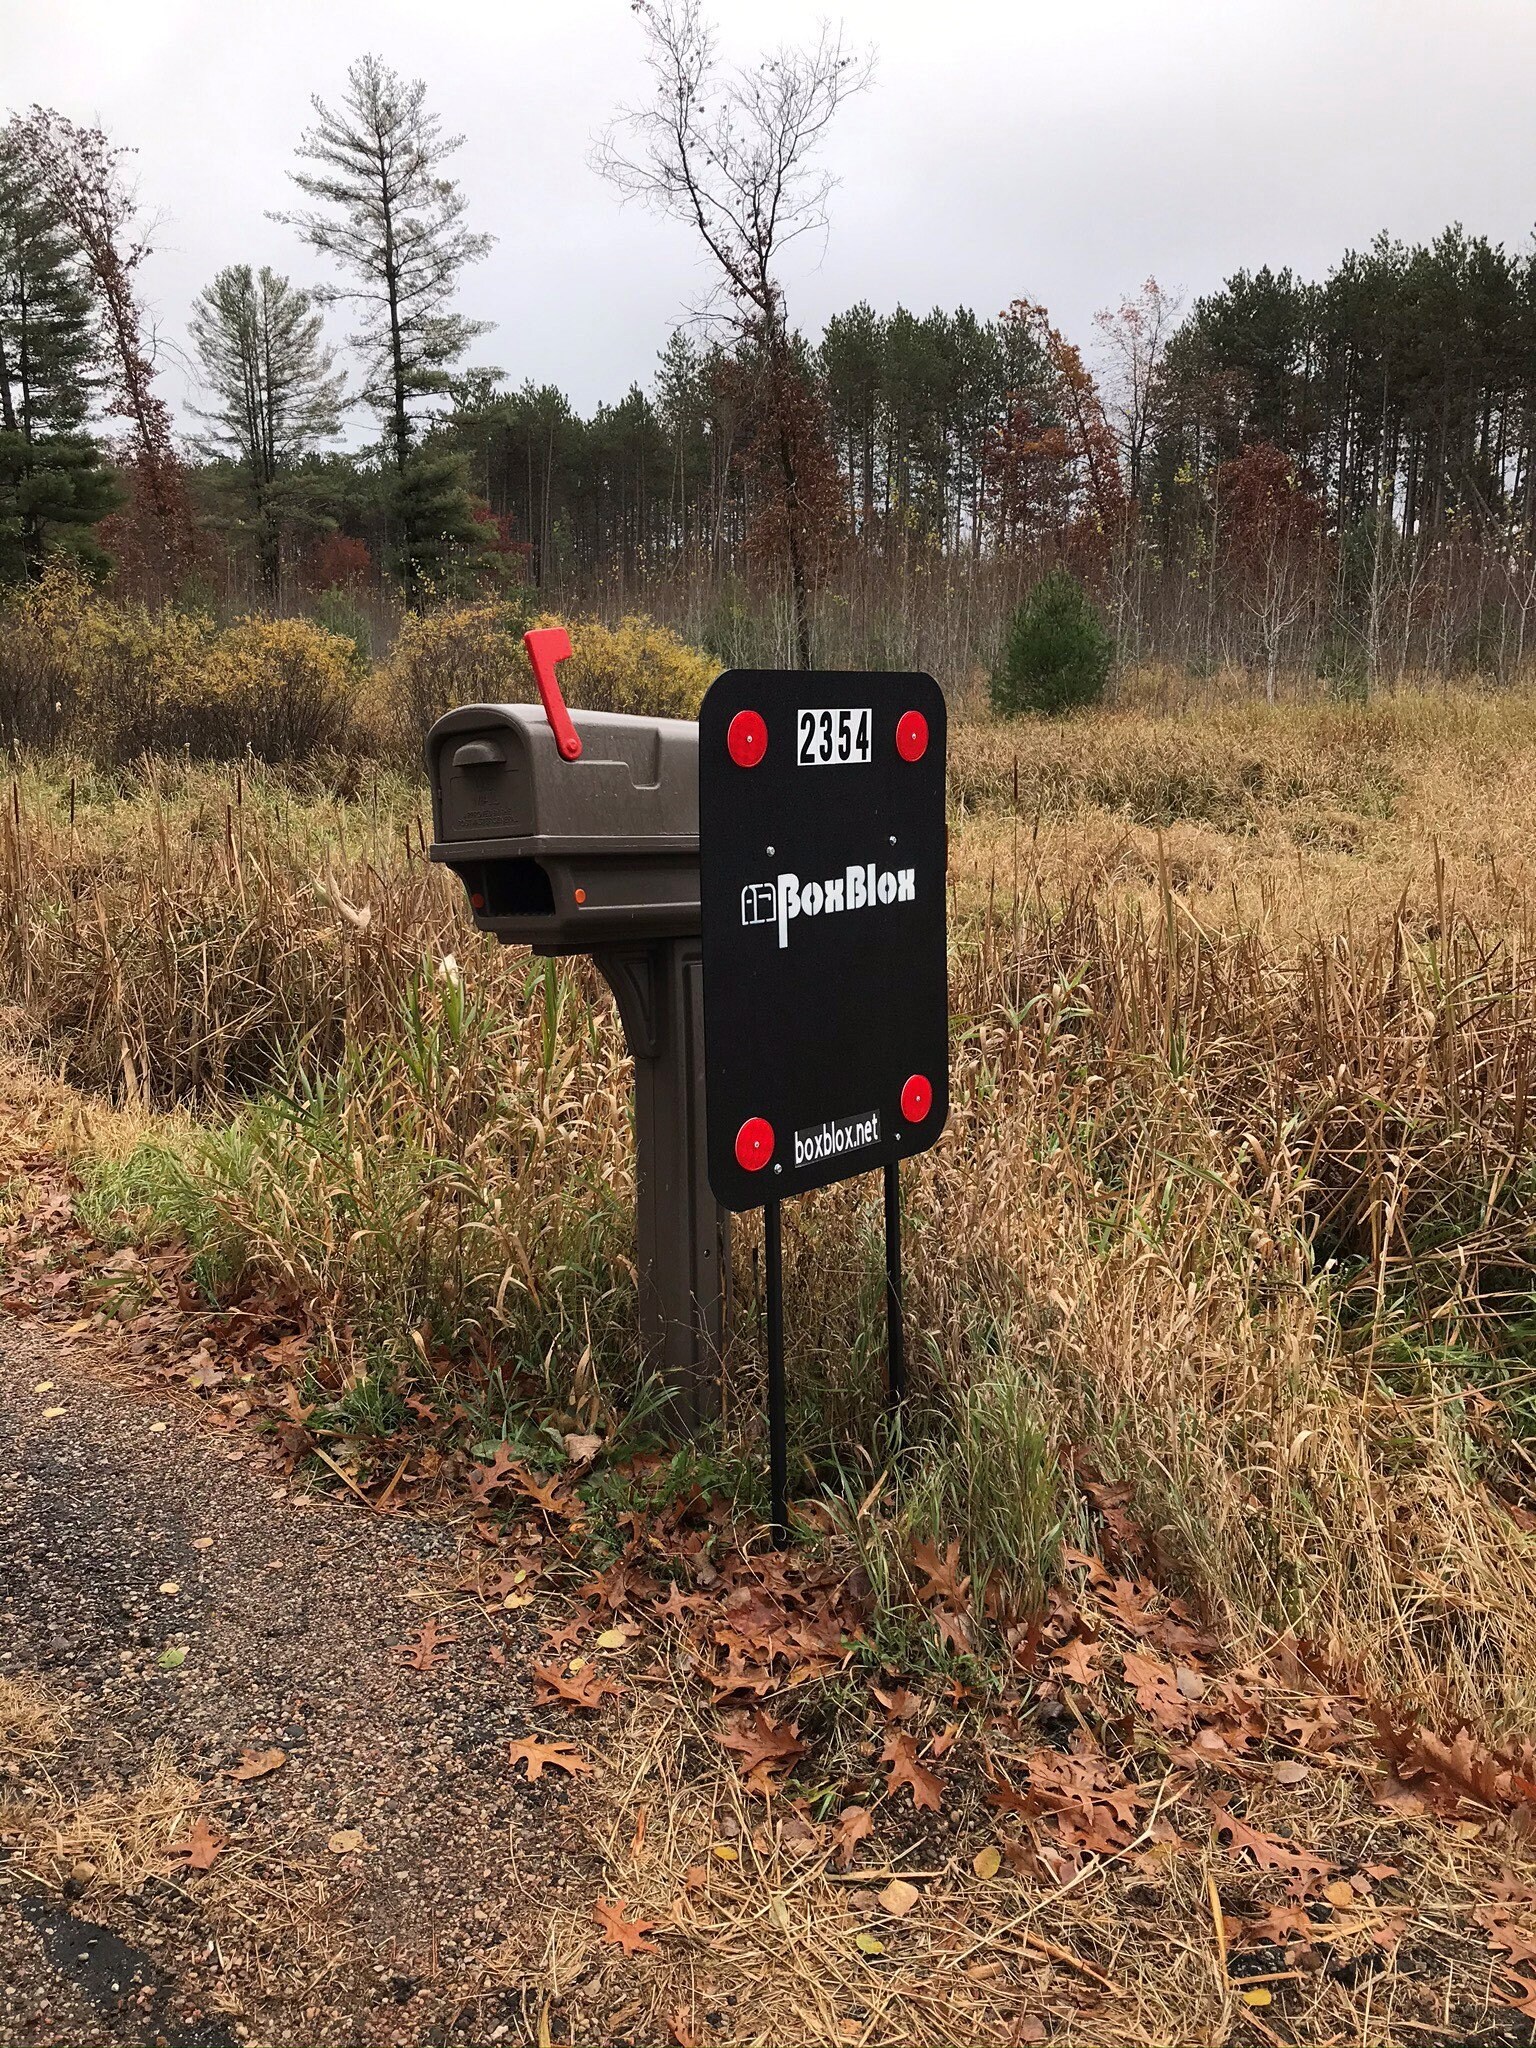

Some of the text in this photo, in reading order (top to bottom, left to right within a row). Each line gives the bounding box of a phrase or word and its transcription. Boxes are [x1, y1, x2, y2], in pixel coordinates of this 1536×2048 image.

[800, 711, 869, 763] 2354
[777, 863, 916, 949] BoxBlox
[794, 1113, 879, 1165] boxblox.net
